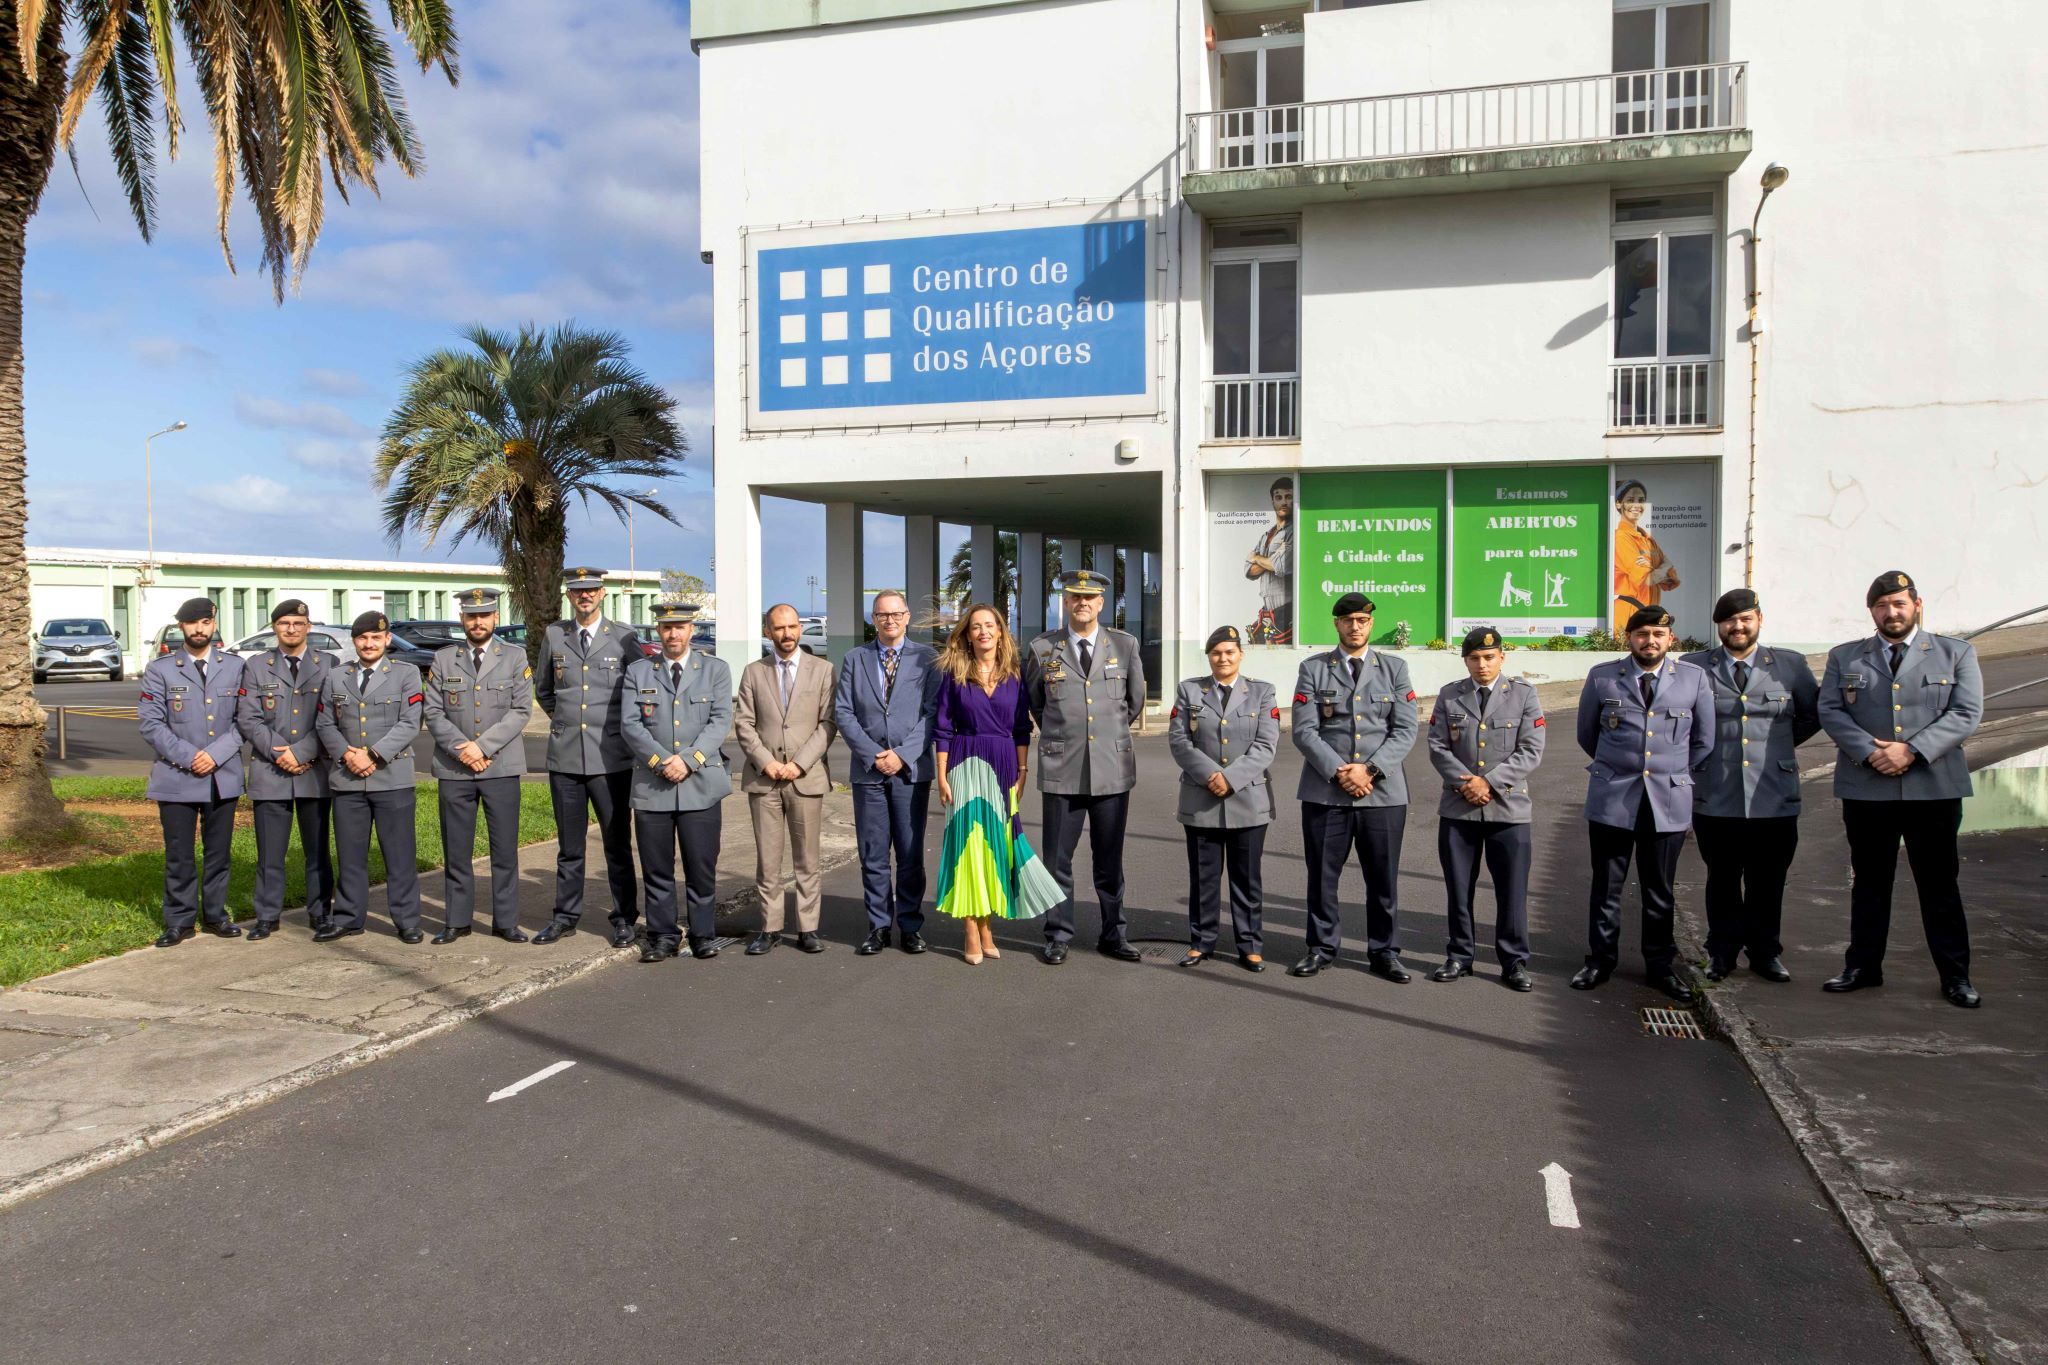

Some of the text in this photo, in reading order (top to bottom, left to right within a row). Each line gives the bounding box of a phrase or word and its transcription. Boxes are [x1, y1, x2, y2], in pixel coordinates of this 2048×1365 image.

[912, 257, 1068, 293] Centro de
[912, 295, 1115, 337] Qualificação
[912, 341, 1092, 374] dos Açores
[1495, 487, 1569, 500] Estamos
[1316, 518, 1433, 533] BEM-VINDOS
[1485, 515, 1578, 529] ABERTOS
[1658, 521, 1709, 530] oportunidade
[1323, 549, 1425, 563] à Cidade das
[1484, 545, 1578, 562] para obras
[1321, 580, 1426, 597] Qualificações
